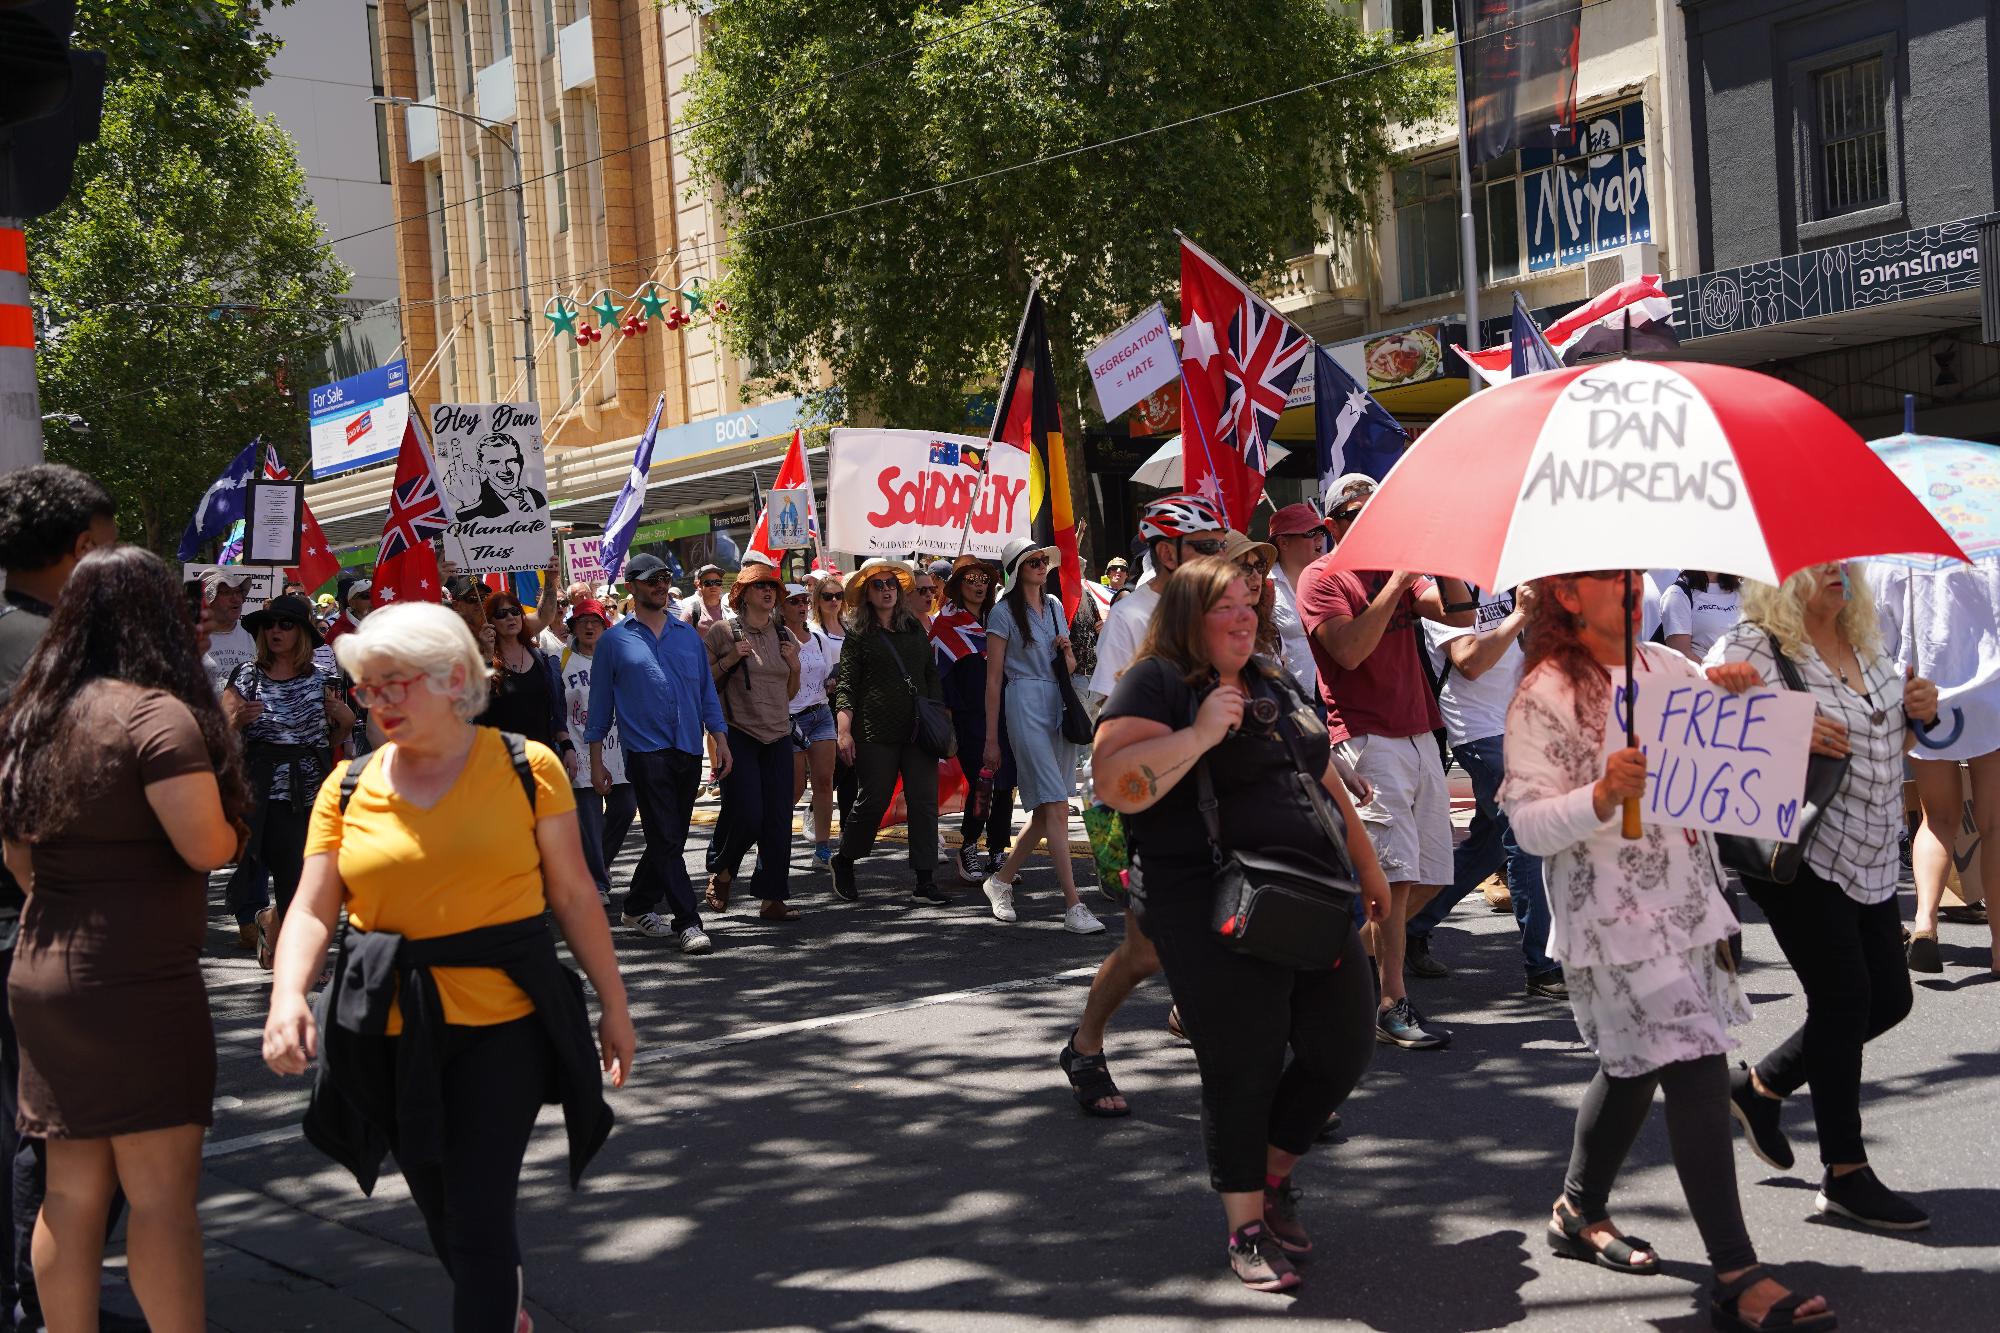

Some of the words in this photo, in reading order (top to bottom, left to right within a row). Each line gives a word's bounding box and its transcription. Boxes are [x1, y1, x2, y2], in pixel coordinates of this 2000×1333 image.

[1530, 243, 1590, 265] JAPANESE
[1602, 230, 1650, 248] MASSAG
[1094, 324, 1164, 380] SEGREGATION
[1127, 357, 1154, 382] HATE
[313, 393, 326, 409] For
[327, 386, 343, 405] Sale
[1567, 378, 1696, 406] SACK
[433, 405, 481, 435] Hey
[492, 405, 537, 432] Dan
[715, 416, 747, 443] BOQ
[1589, 403, 1687, 451] DAN
[1522, 451, 1738, 510] ANDREWS
[447, 519, 546, 538] Mandate
[470, 545, 514, 560] This
[569, 544, 577, 554] I
[1658, 687, 1778, 756] FREE
[1641, 745, 1762, 826] HUGS
